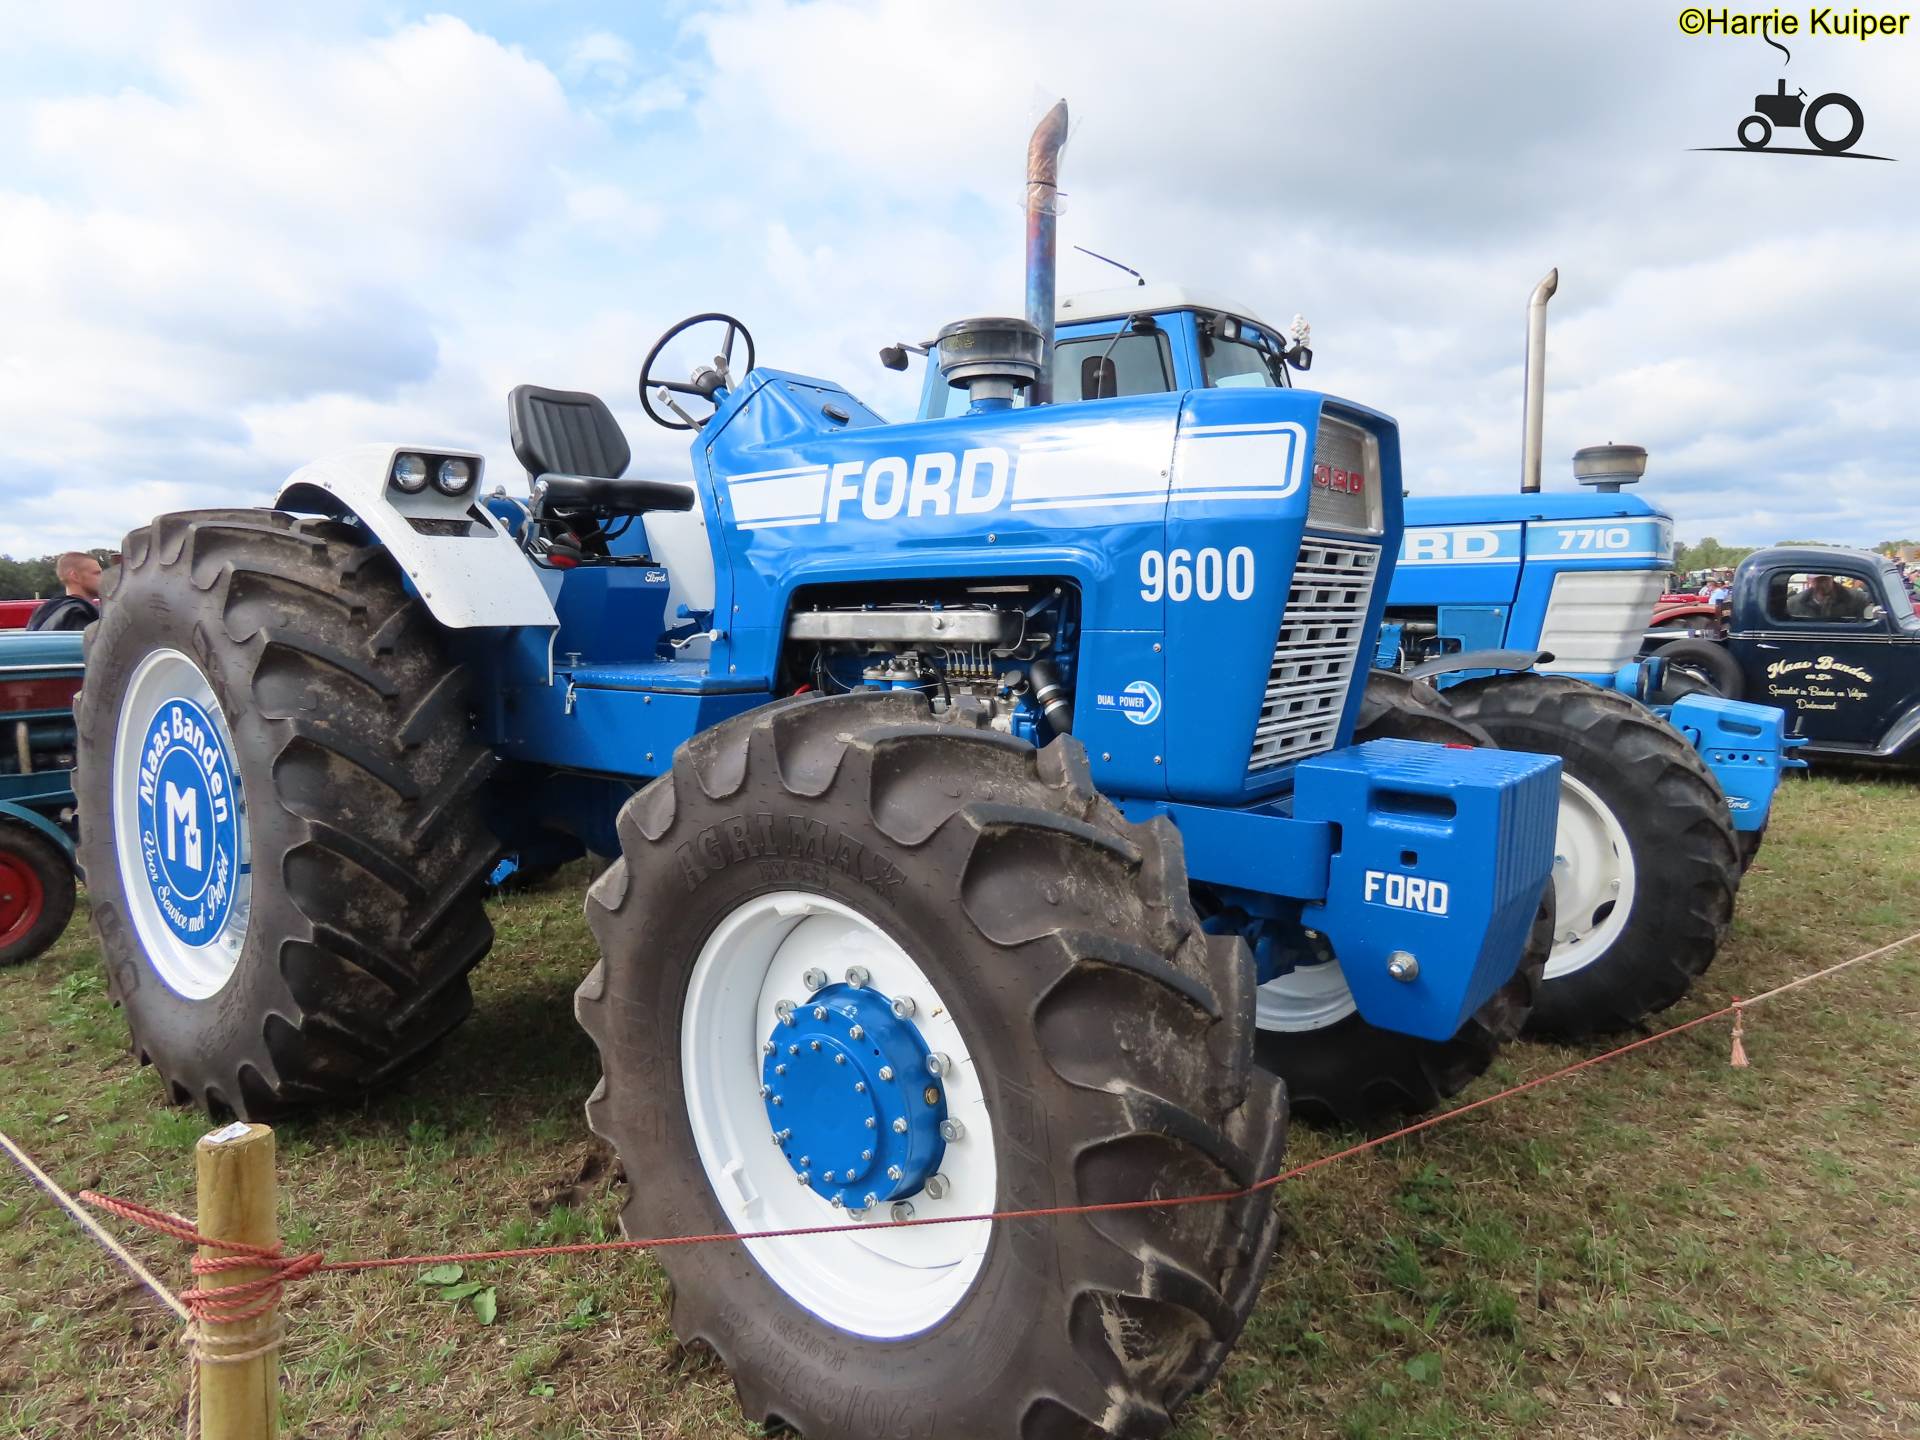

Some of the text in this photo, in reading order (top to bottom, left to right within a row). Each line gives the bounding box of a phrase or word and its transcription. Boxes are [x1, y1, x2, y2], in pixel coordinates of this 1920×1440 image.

[825, 446, 1010, 524] FORD
[1404, 530, 1500, 560] RD
[1557, 527, 1630, 550] 7710
[645, 570, 667, 583] Ford
[1138, 545, 1256, 603] 9600
[1814, 656, 1873, 683] Banden
[1097, 694, 1145, 708] DUAL POWER
[140, 706, 228, 823] Maas Banden
[157, 885, 188, 930] Service
[188, 902, 206, 932] met
[1363, 870, 1449, 916] FORD
